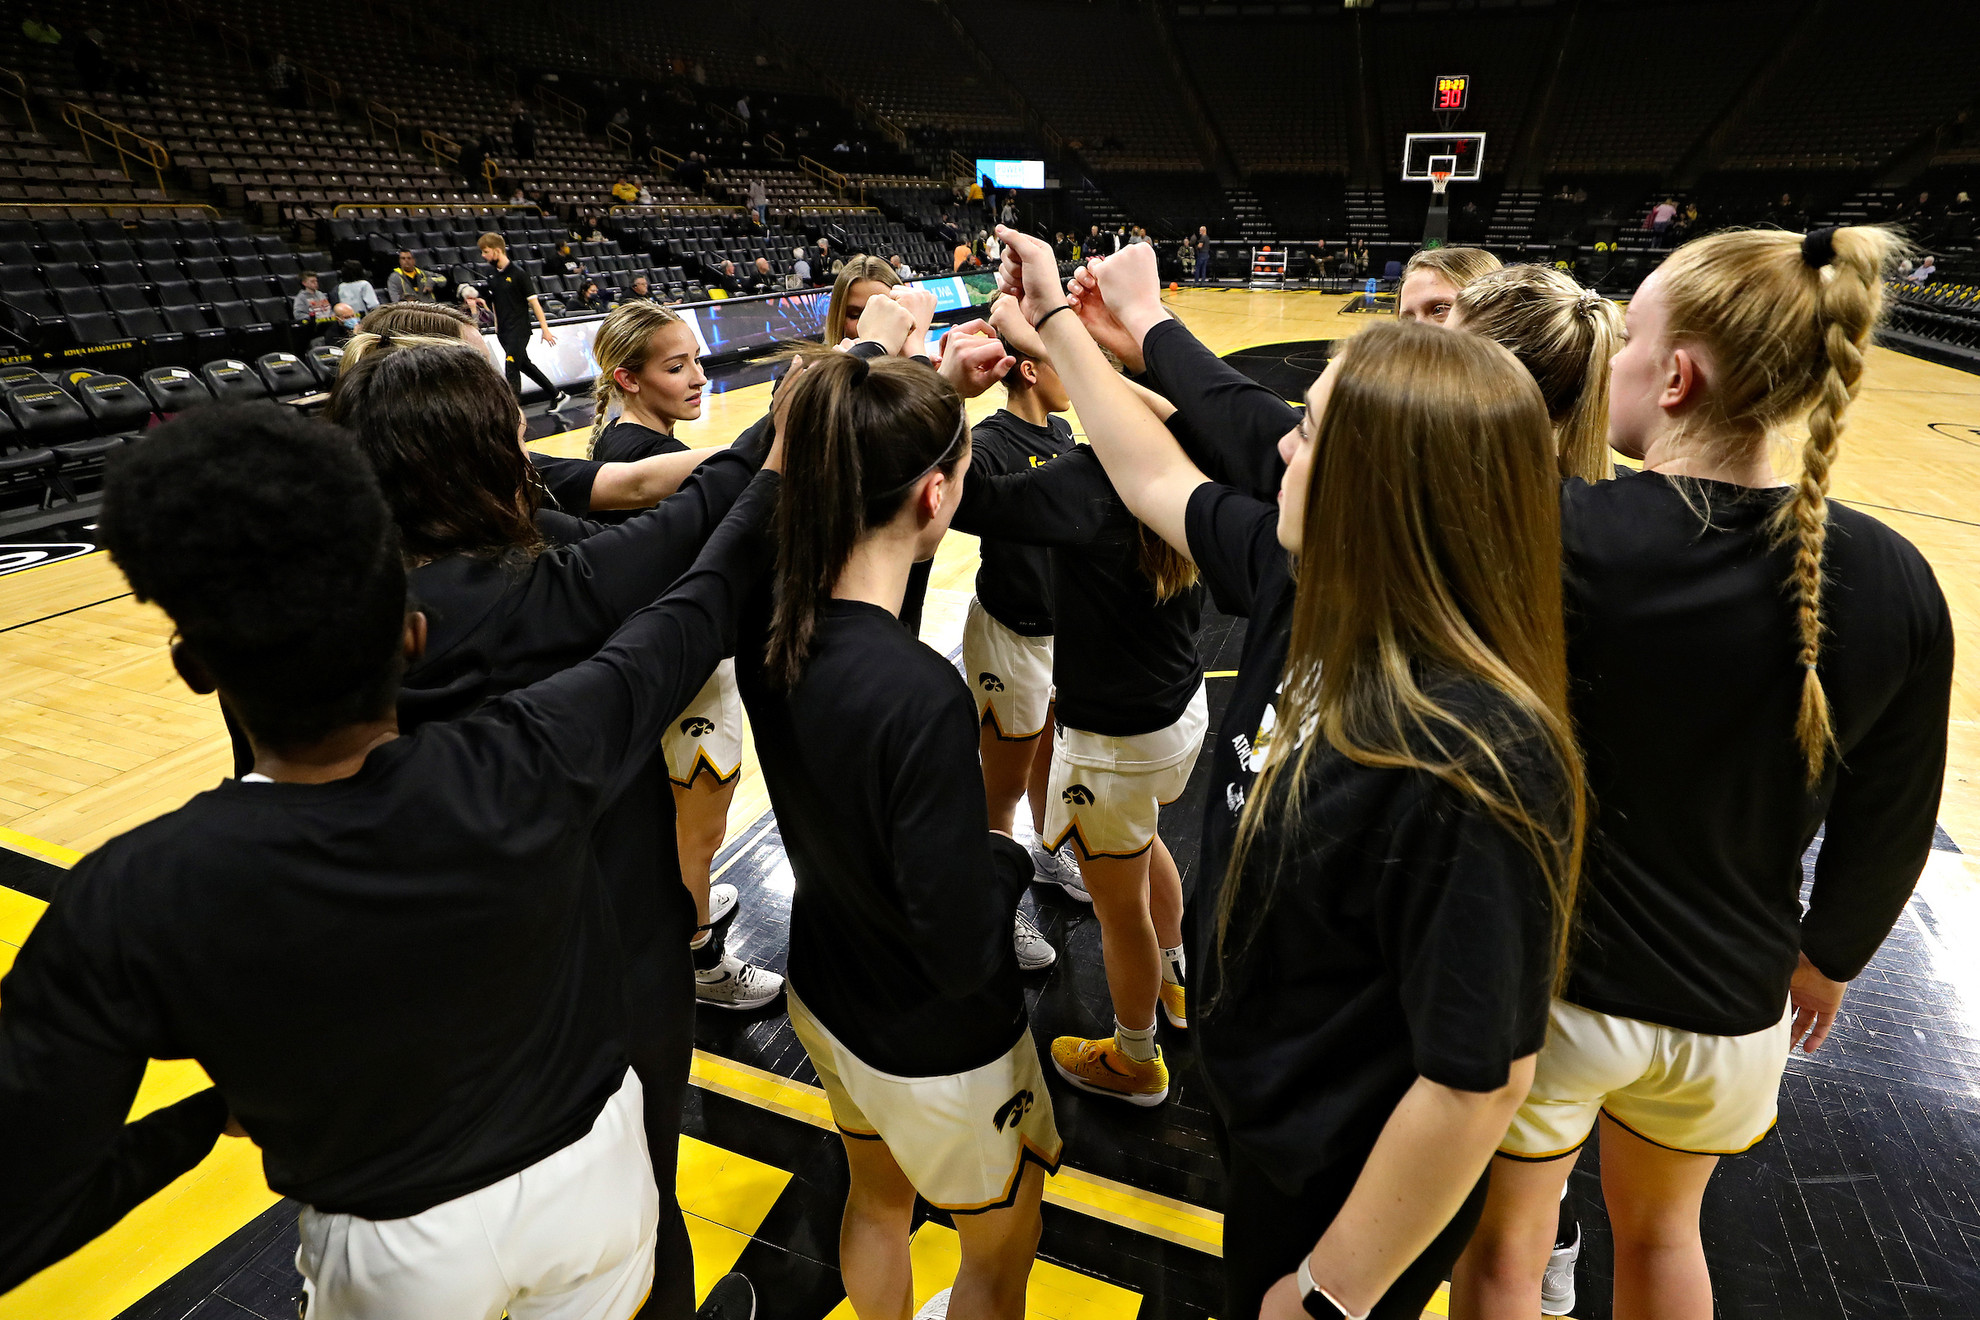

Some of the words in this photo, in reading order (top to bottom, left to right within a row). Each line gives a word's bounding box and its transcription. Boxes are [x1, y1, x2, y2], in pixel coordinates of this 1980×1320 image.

[1440, 90, 1461, 107] 30
[64, 348, 86, 357] IOWA
[87, 342, 132, 353] HAWKEYES
[0, 354, 32, 364] KEYES
